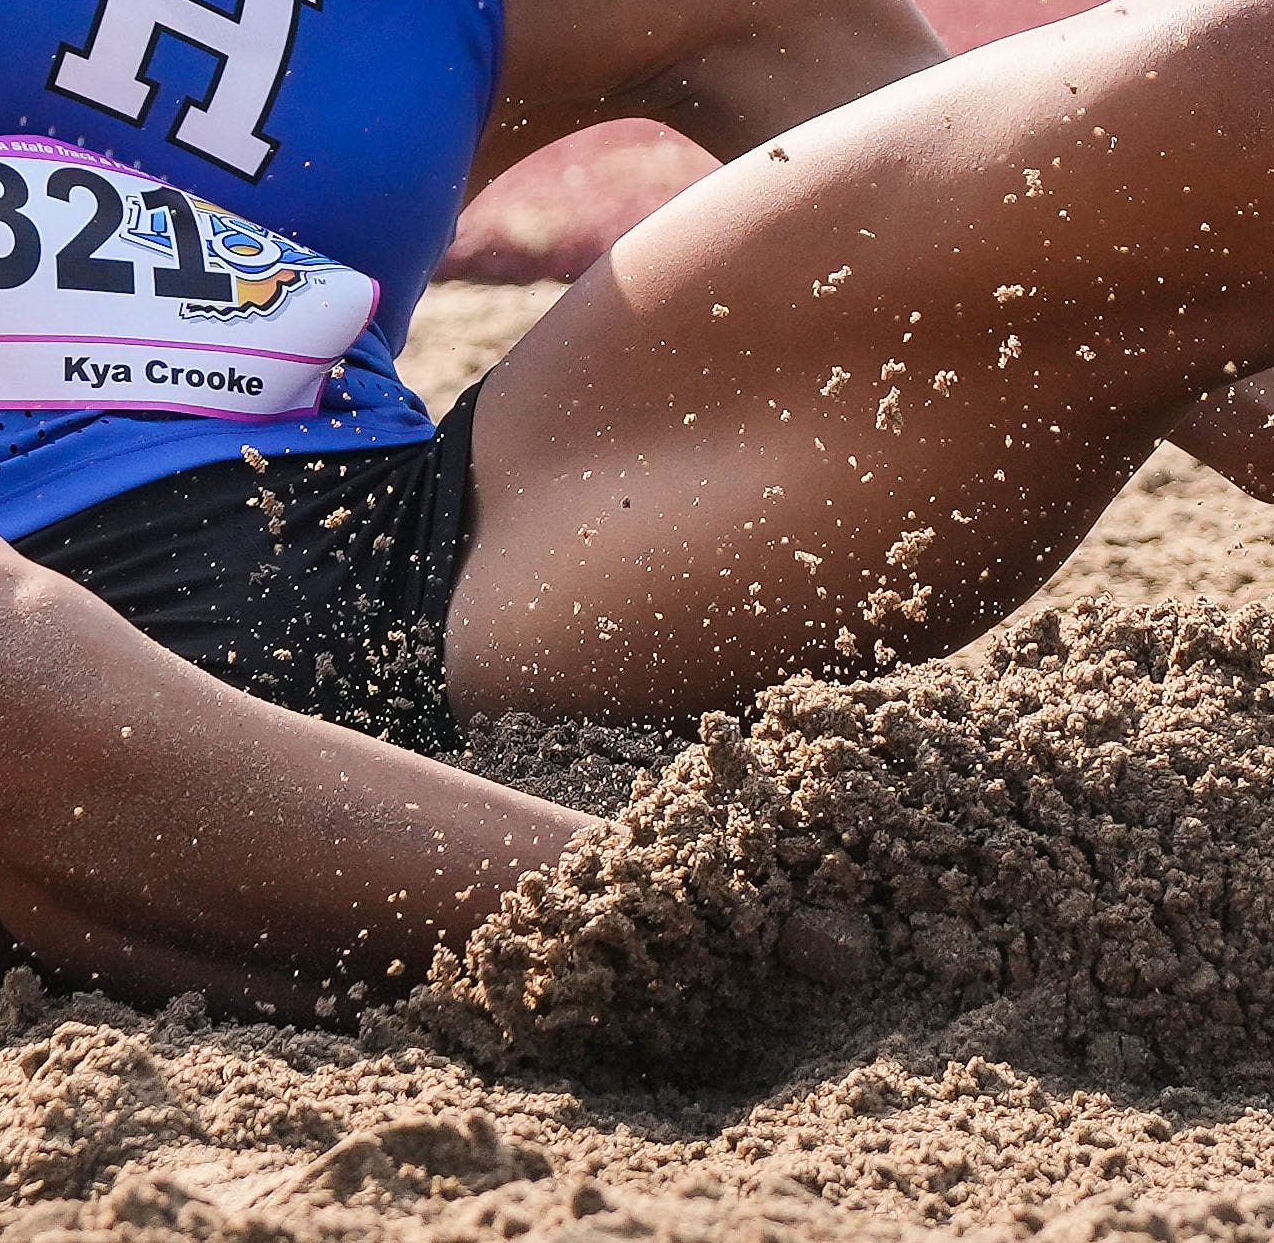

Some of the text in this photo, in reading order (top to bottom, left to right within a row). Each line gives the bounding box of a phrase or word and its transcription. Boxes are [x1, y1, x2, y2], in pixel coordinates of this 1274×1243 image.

[11, 141, 54, 155] State
[54, 144, 98, 163] Track
[64, 356, 265, 396] Kya Crooke
